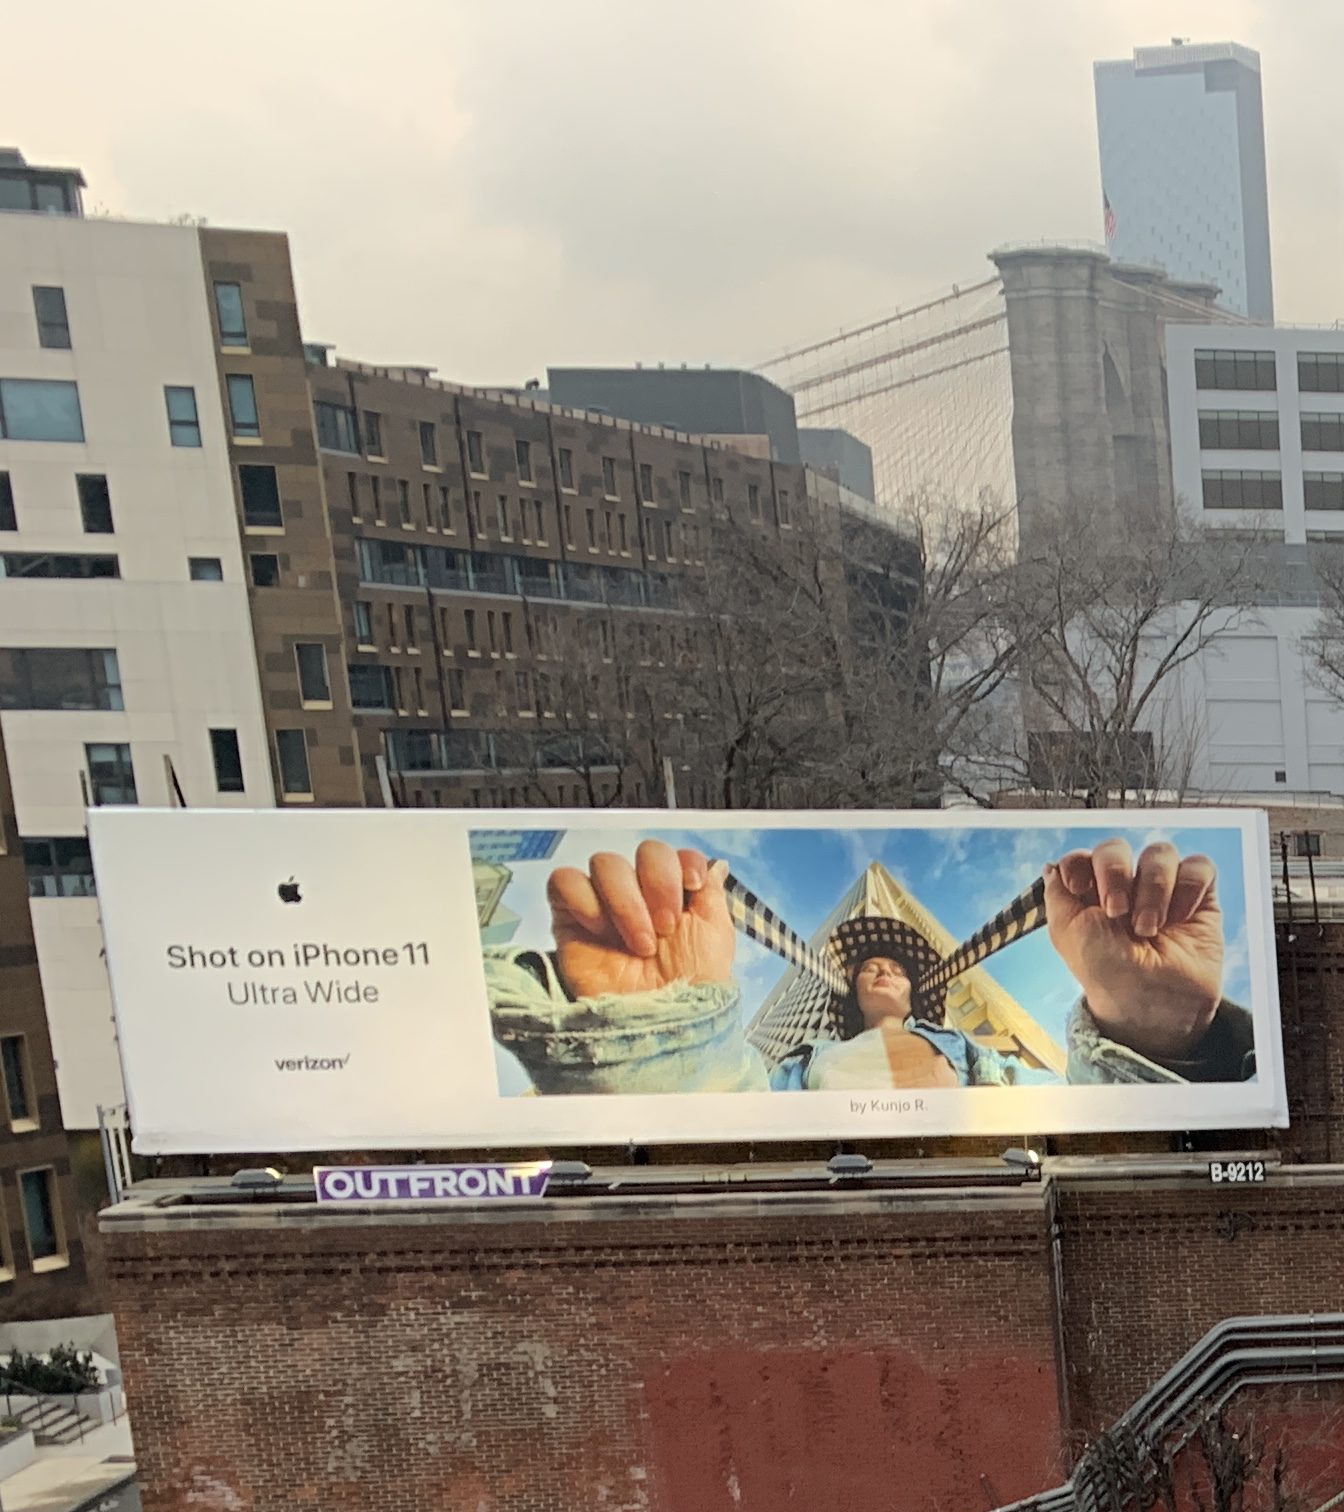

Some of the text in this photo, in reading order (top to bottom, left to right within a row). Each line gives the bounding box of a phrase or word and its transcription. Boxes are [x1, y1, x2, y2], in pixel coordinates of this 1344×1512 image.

[167, 942, 430, 968] Shot on iPhone 11
[227, 979, 379, 1005] Ultra Wide
[275, 1055, 345, 1071] verizon
[850, 1099, 866, 1114] by
[324, 1168, 541, 1198] OUTFRONT
[1211, 1161, 1264, 1182] B-9212
